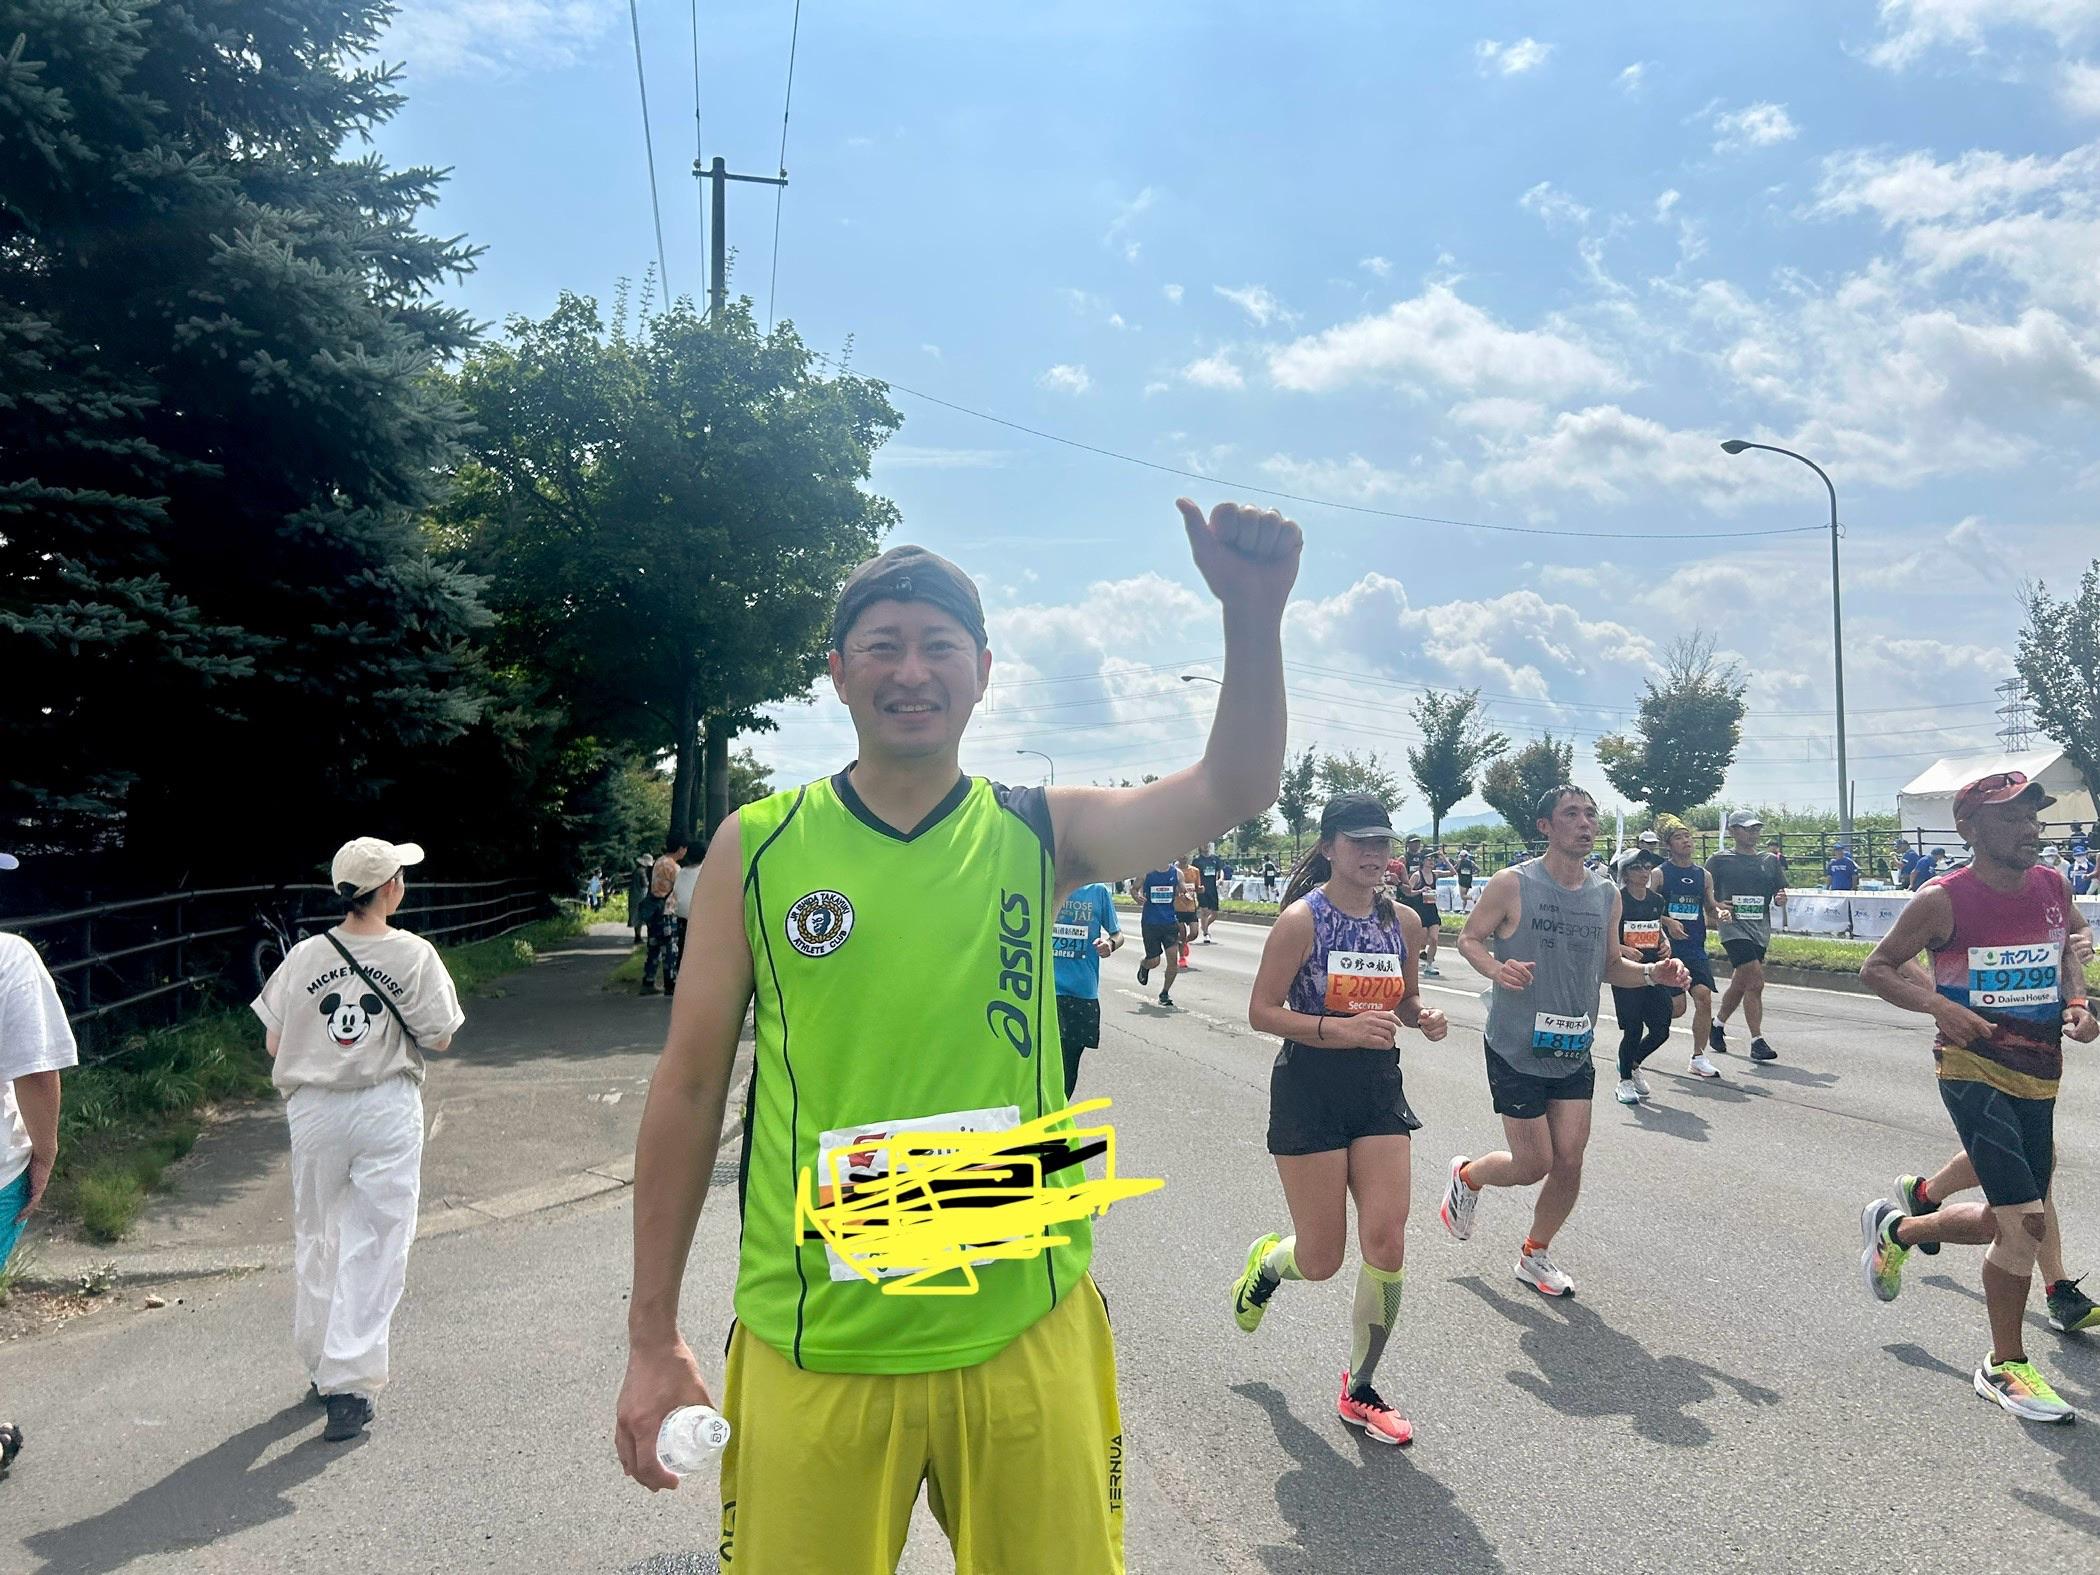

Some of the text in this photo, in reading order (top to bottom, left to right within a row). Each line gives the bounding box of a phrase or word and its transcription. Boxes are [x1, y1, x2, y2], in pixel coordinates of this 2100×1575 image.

[820, 893, 851, 915] TAKAYUKI
[1531, 918, 1603, 938] MOVESPORT
[793, 930, 847, 954] ATHLETE CLUB
[2000, 948, 2050, 966] ホクレン
[306, 965, 404, 998] MICKEY MOUSE
[1332, 974, 1403, 998] E 20702
[1994, 966, 2057, 991] 9299
[1347, 1001, 1384, 1010] Secoma
[1998, 993, 2050, 1004] Daiwa House
[1110, 1434, 1122, 1514] TERNUA
